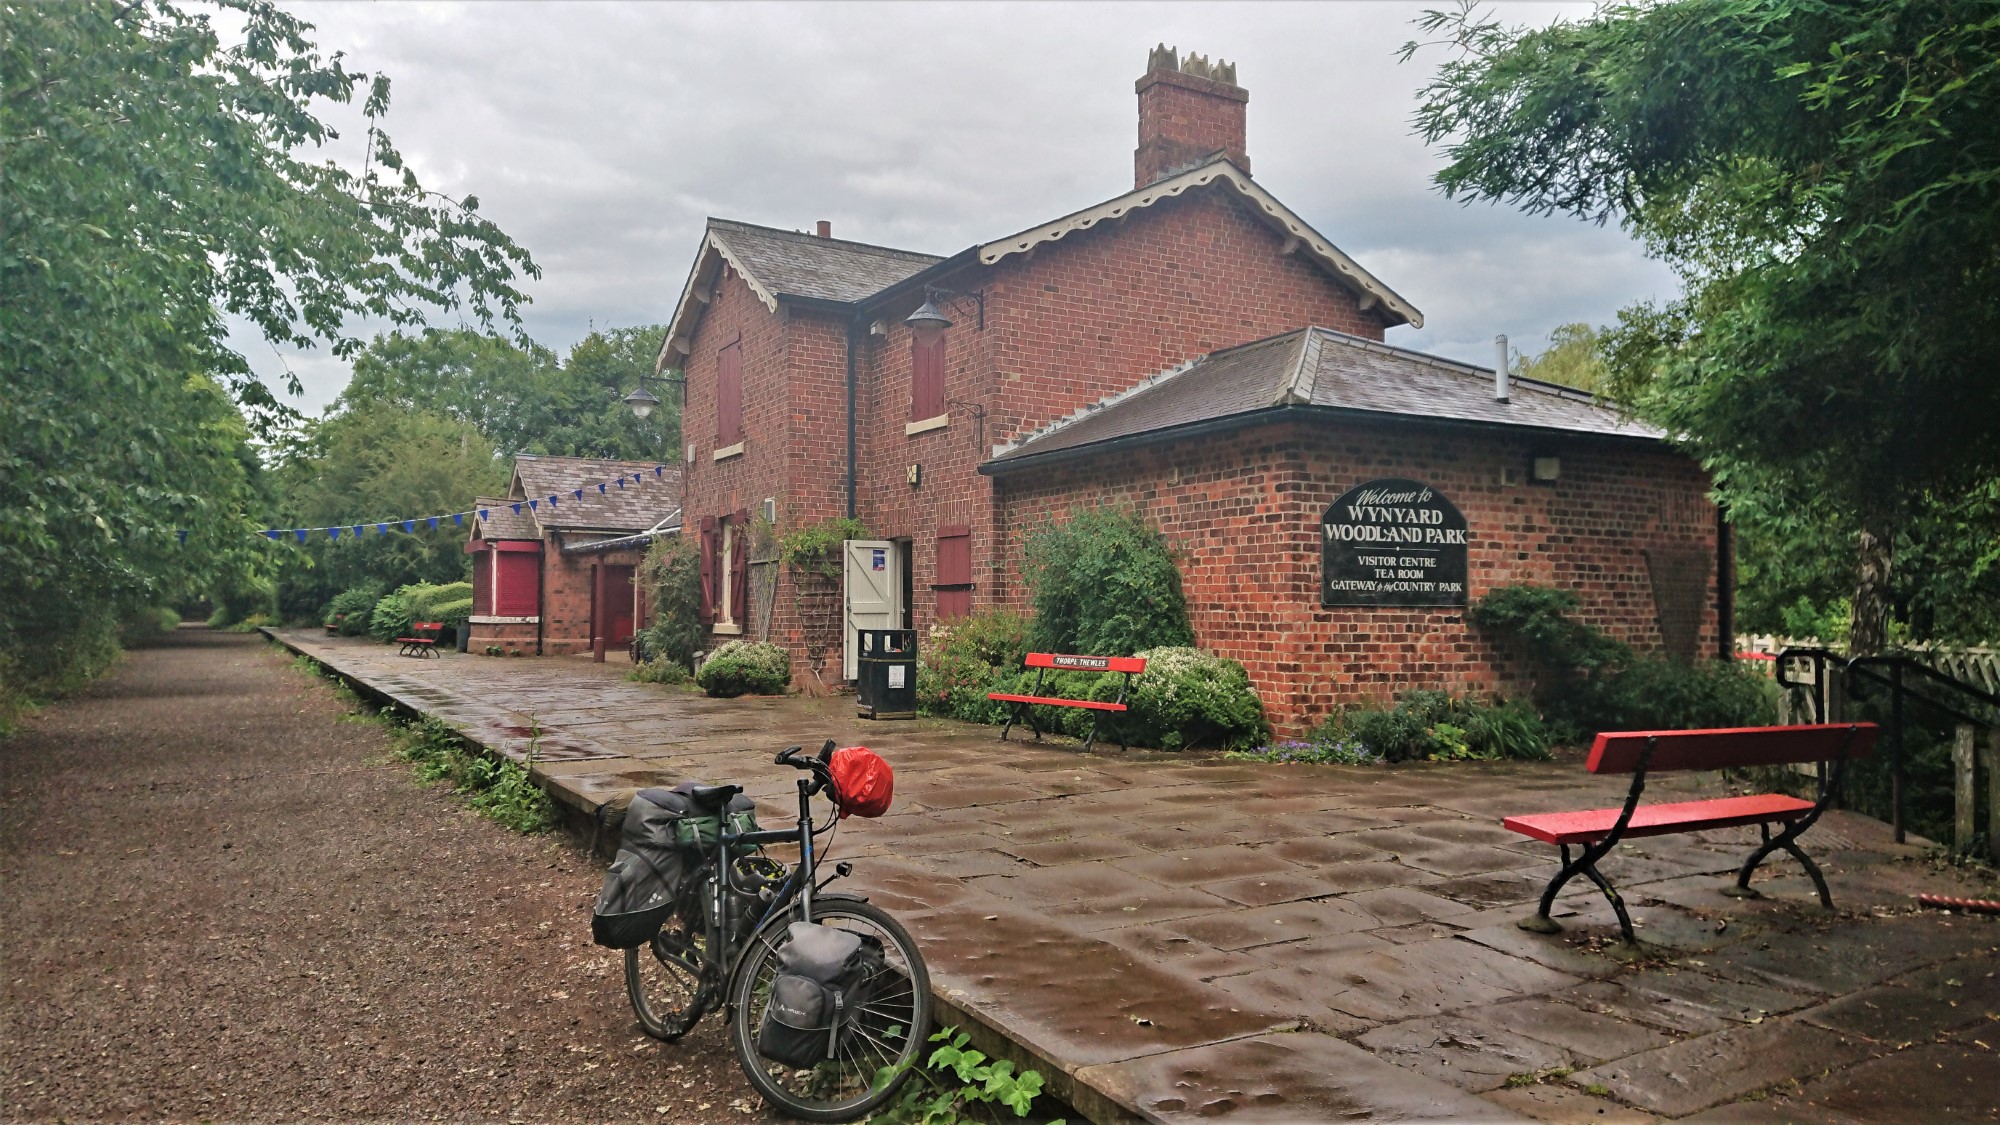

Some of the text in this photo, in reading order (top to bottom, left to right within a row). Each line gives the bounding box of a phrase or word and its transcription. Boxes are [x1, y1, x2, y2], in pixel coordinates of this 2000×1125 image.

[1356, 486, 1433, 506] Welcome to
[1347, 505, 1443, 525] WYNYARD
[1324, 524, 1467, 545] WOODLAND PARK
[1358, 555, 1437, 568] VISITOR CENTRE
[1374, 568, 1424, 579] TEA ROOM
[1331, 580, 1377, 591] GATEWAY
[1393, 581, 1436, 592] COUNTRY
[1439, 582, 1462, 592] PARK
[1056, 657, 1106, 667] THORPE THEWLES
